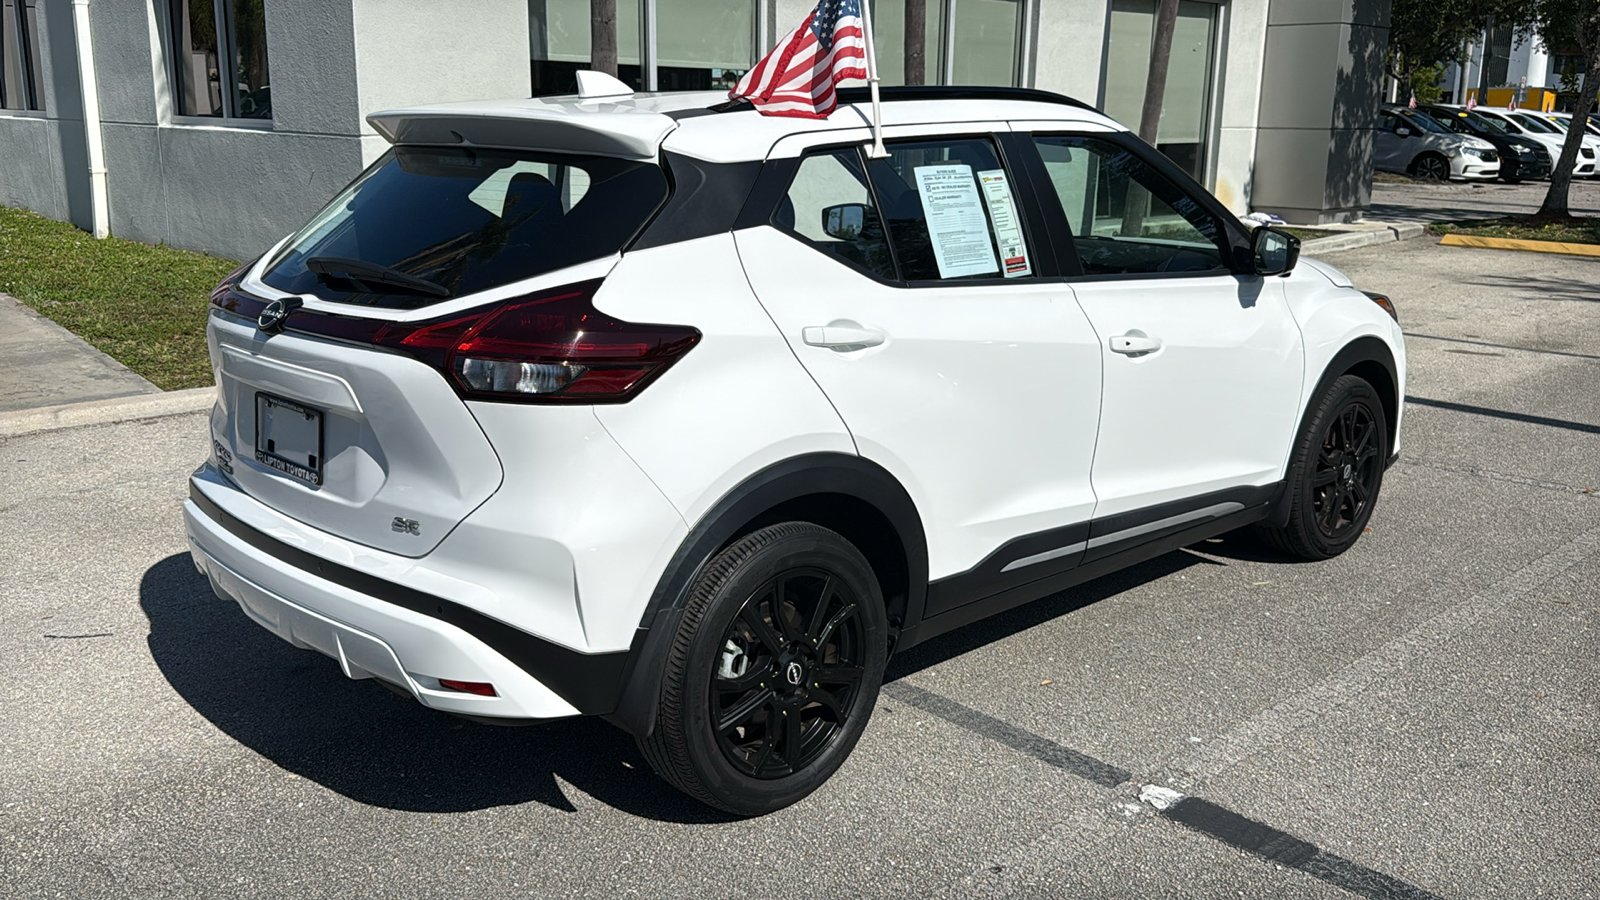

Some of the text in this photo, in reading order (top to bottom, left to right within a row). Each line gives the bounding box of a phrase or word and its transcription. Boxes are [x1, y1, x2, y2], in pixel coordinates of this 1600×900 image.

[264, 454, 310, 481] LIPTON TOYOTA
[391, 516, 421, 536] SR
